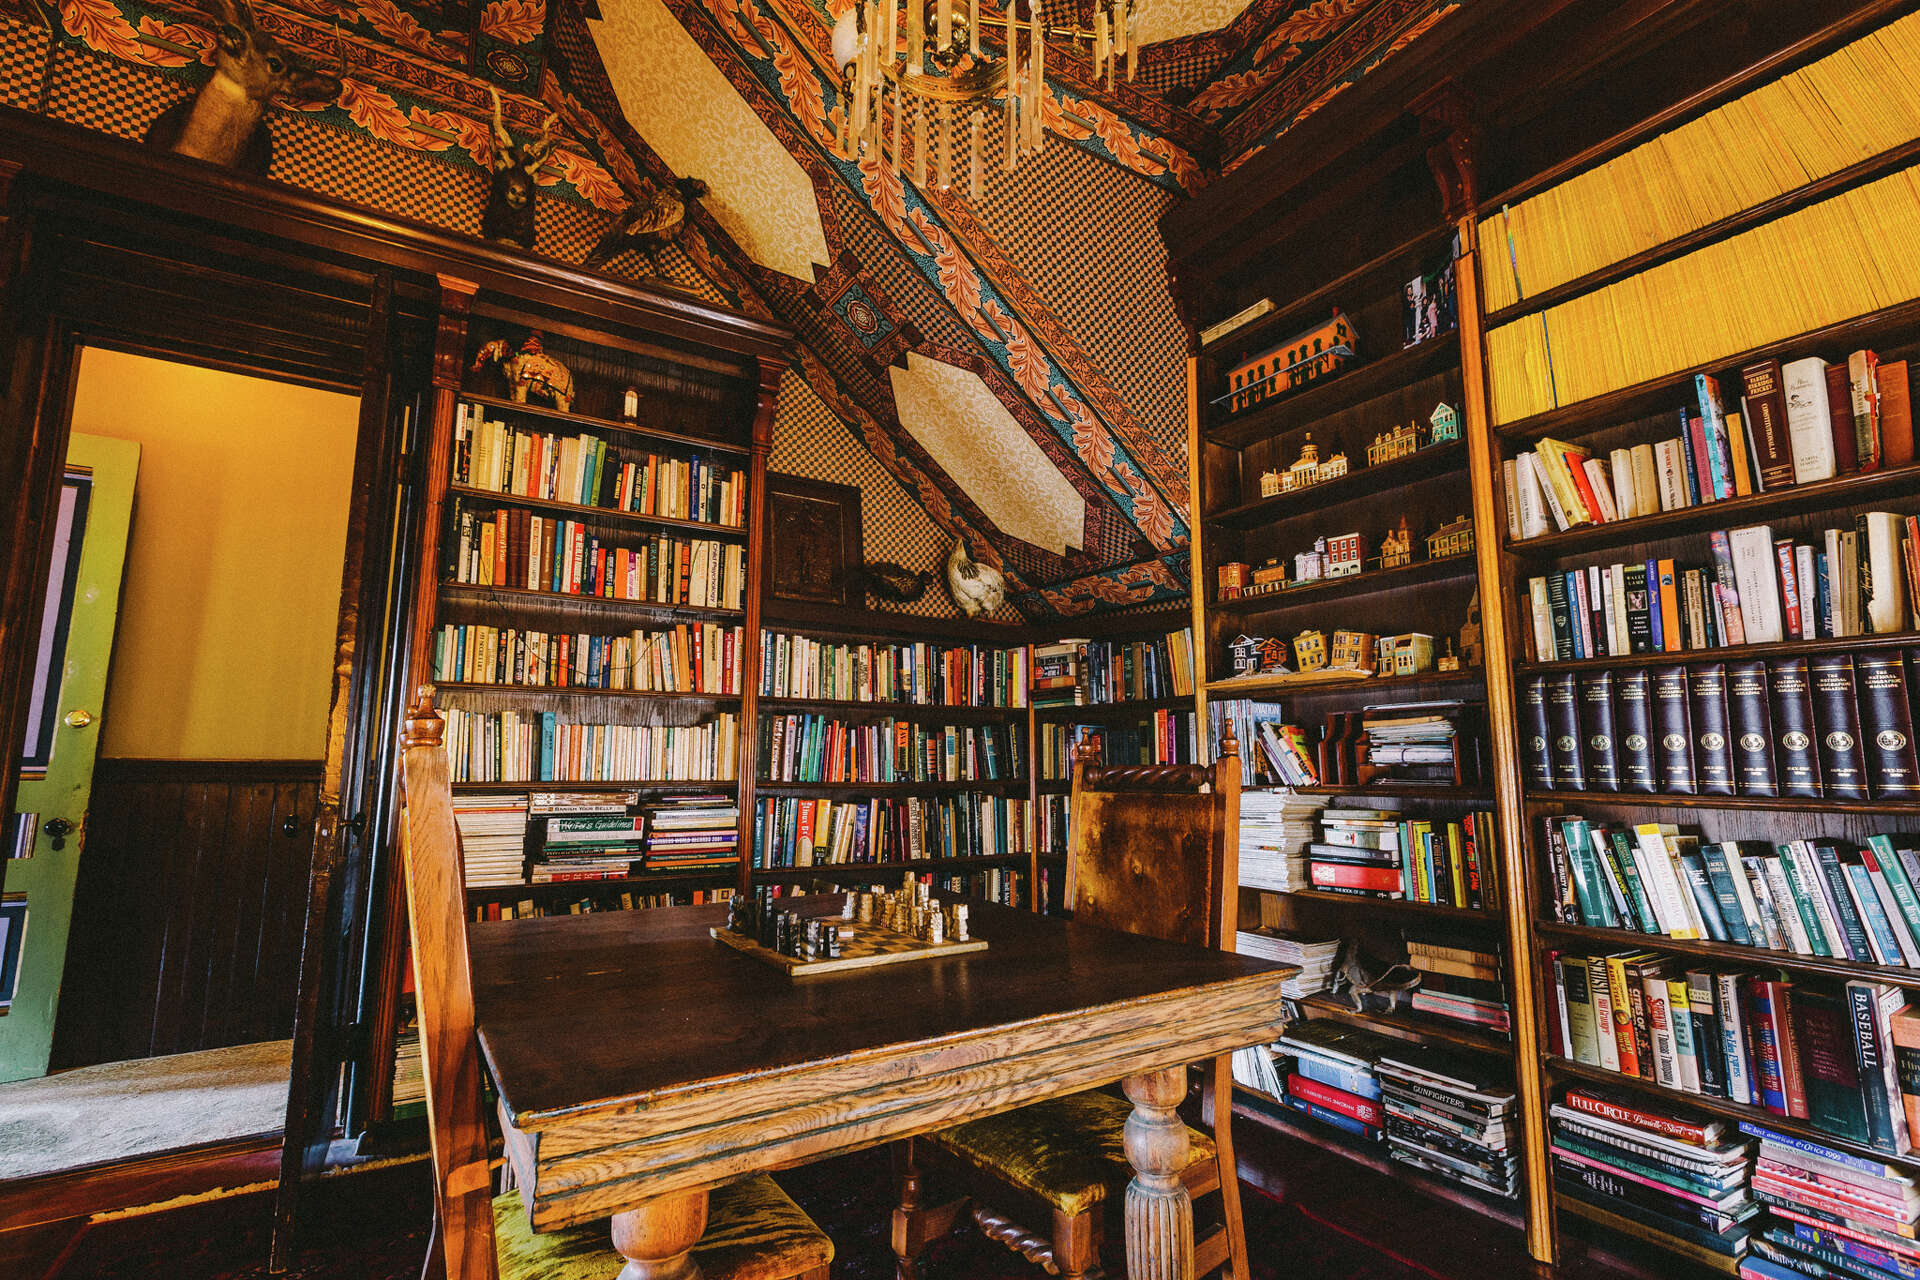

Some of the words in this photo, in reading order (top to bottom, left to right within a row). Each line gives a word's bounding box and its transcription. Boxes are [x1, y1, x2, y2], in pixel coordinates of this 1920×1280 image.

[561, 821, 592, 830] Writer's
[595, 820, 632, 829] Guidelines
[801, 805, 810, 823] Linux
[1557, 865, 1566, 886] FRAILTY
[1588, 956, 1609, 994] SCHISM
[1632, 988, 1643, 1017] CITIES
[1854, 992, 1877, 1068] BASEBALL
[1413, 1085, 1465, 1109] GUNFIGHTERS
[1572, 1095, 1595, 1112] FULL
[1595, 1102, 1631, 1121] CIRCLE
[1633, 1114, 1662, 1131] Danielle
[1742, 1123, 1754, 1131] the
[1753, 1127, 1766, 1136] best
[1766, 1132, 1794, 1146] american
[1759, 1192, 1775, 1203] Path
[1786, 1200, 1810, 1215] Liberty
[1782, 1235, 1813, 1253] STIFF
[1846, 1261, 1865, 1273] MARY
[1803, 1262, 1823, 1277] War
